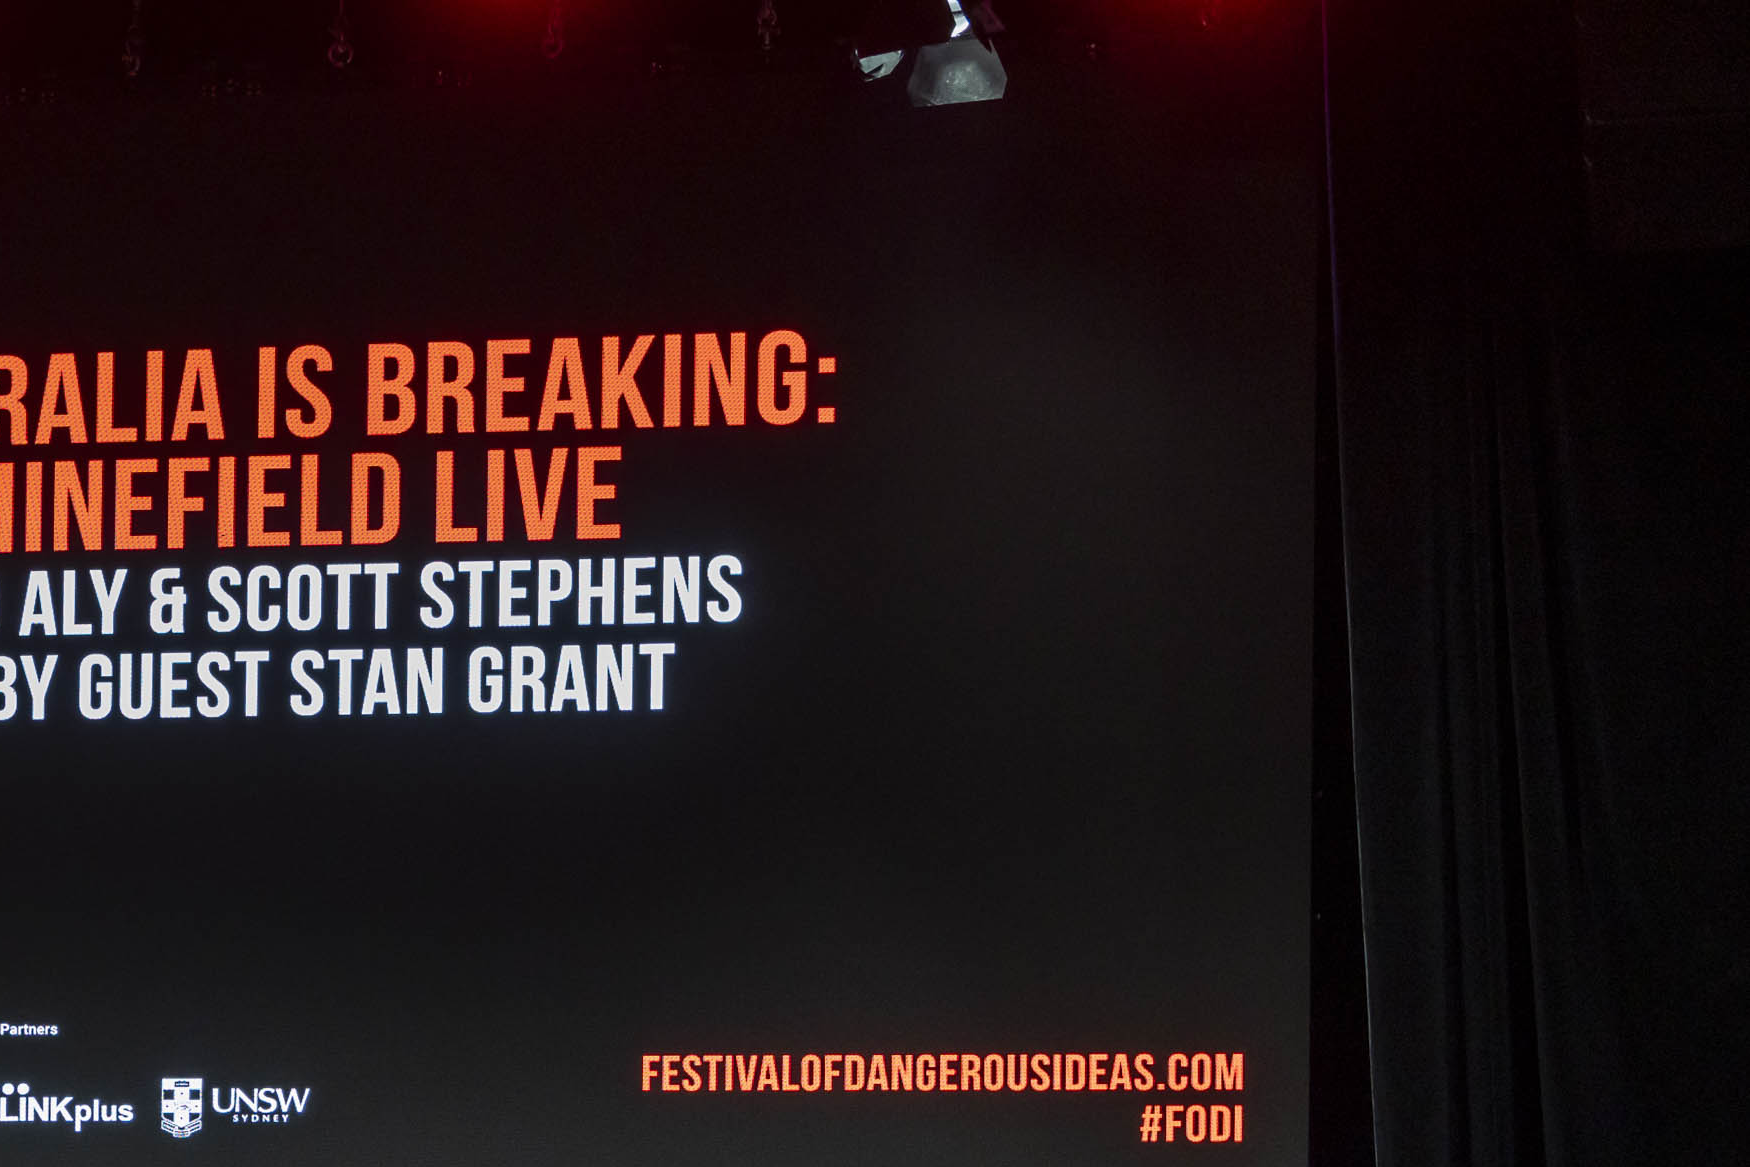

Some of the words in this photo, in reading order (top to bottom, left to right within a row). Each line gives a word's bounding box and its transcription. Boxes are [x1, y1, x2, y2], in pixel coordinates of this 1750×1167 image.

[258, 345, 333, 438] IS
[367, 330, 836, 435] BREAKING:
[436, 446, 622, 542] LIVE
[19, 569, 128, 636] ALY
[150, 568, 187, 634] &
[208, 563, 399, 632] SCOTT
[420, 555, 742, 628] STEPHENS
[79, 651, 270, 719] GUEST
[290, 648, 443, 716] STAN
[468, 643, 675, 713] GRANT
[0, 1023, 58, 1036] Partners
[642, 1052, 1243, 1092] FESTIVALOFDANGEROUSIDEAS.COM
[212, 1088, 310, 1114] UNSW
[233, 1114, 289, 1123] SYDNEY
[1140, 1104, 1243, 1143] #FODI
